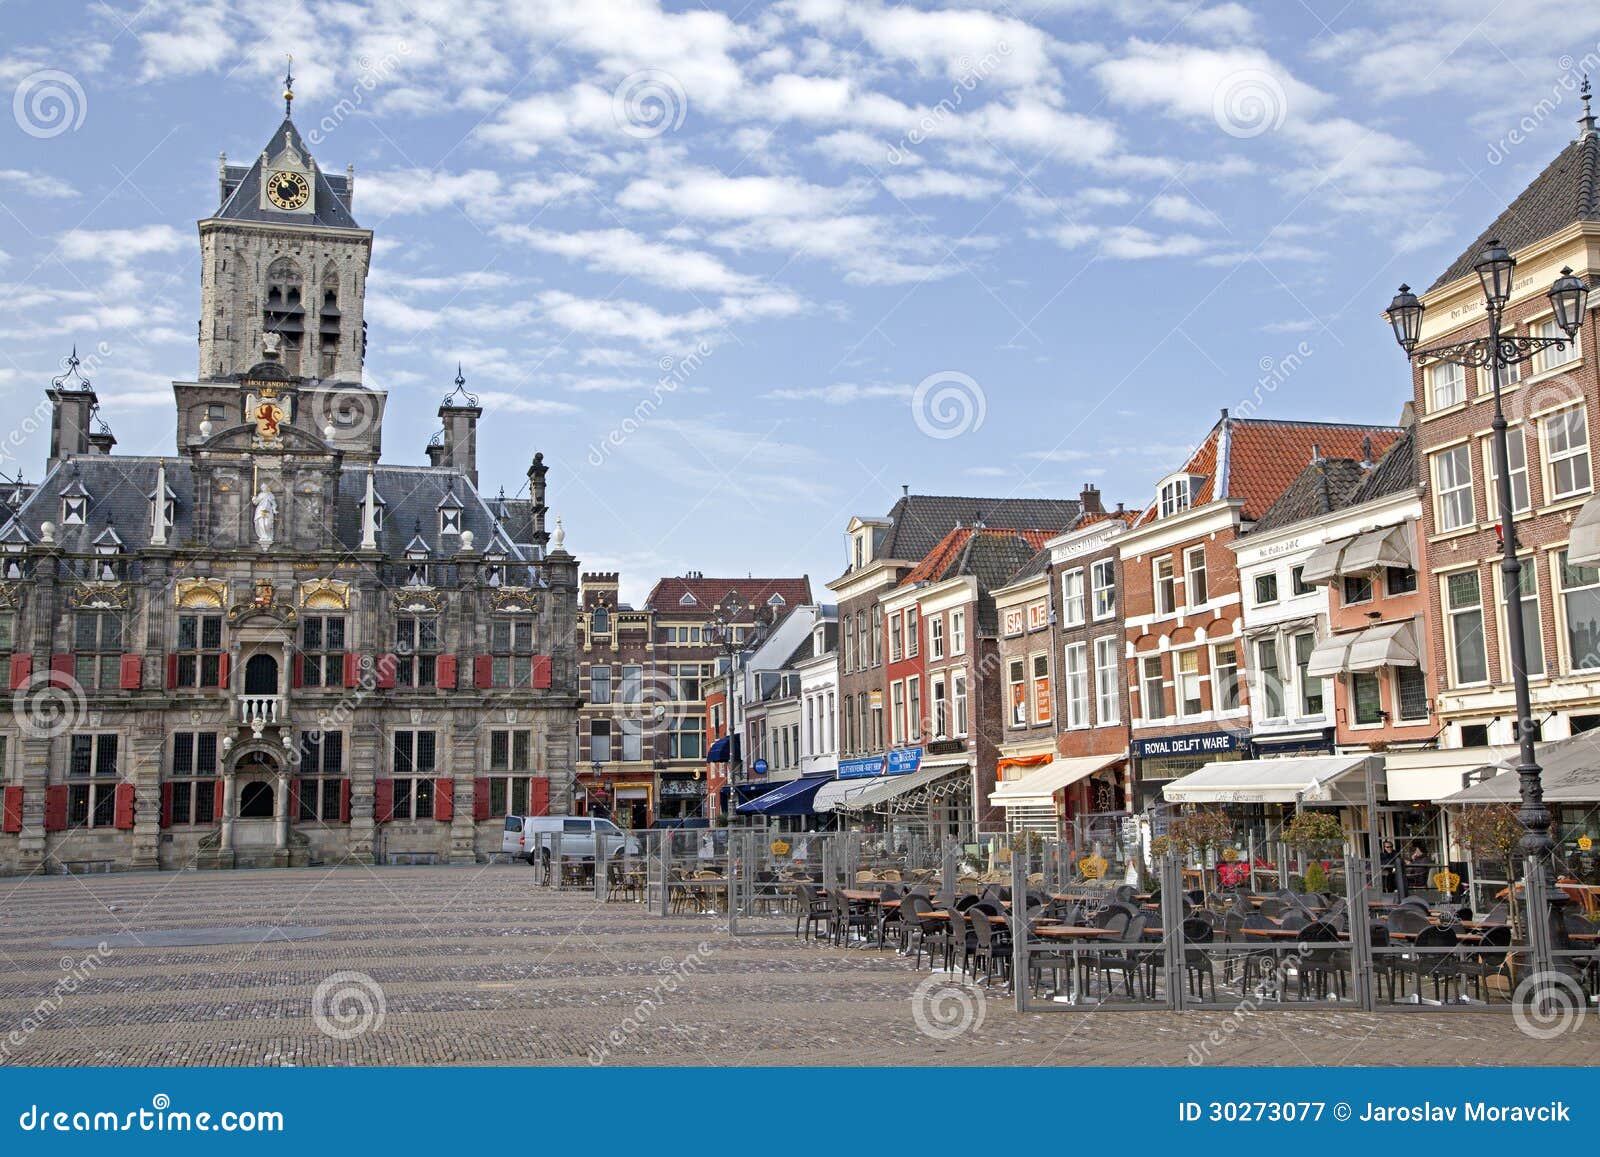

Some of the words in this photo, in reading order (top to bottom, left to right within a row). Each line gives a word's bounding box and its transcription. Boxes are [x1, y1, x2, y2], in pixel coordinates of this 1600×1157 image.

[1144, 742, 1170, 754] ROYAL
[1172, 739, 1200, 752] DELFT
[1202, 736, 1230, 749] WARE
